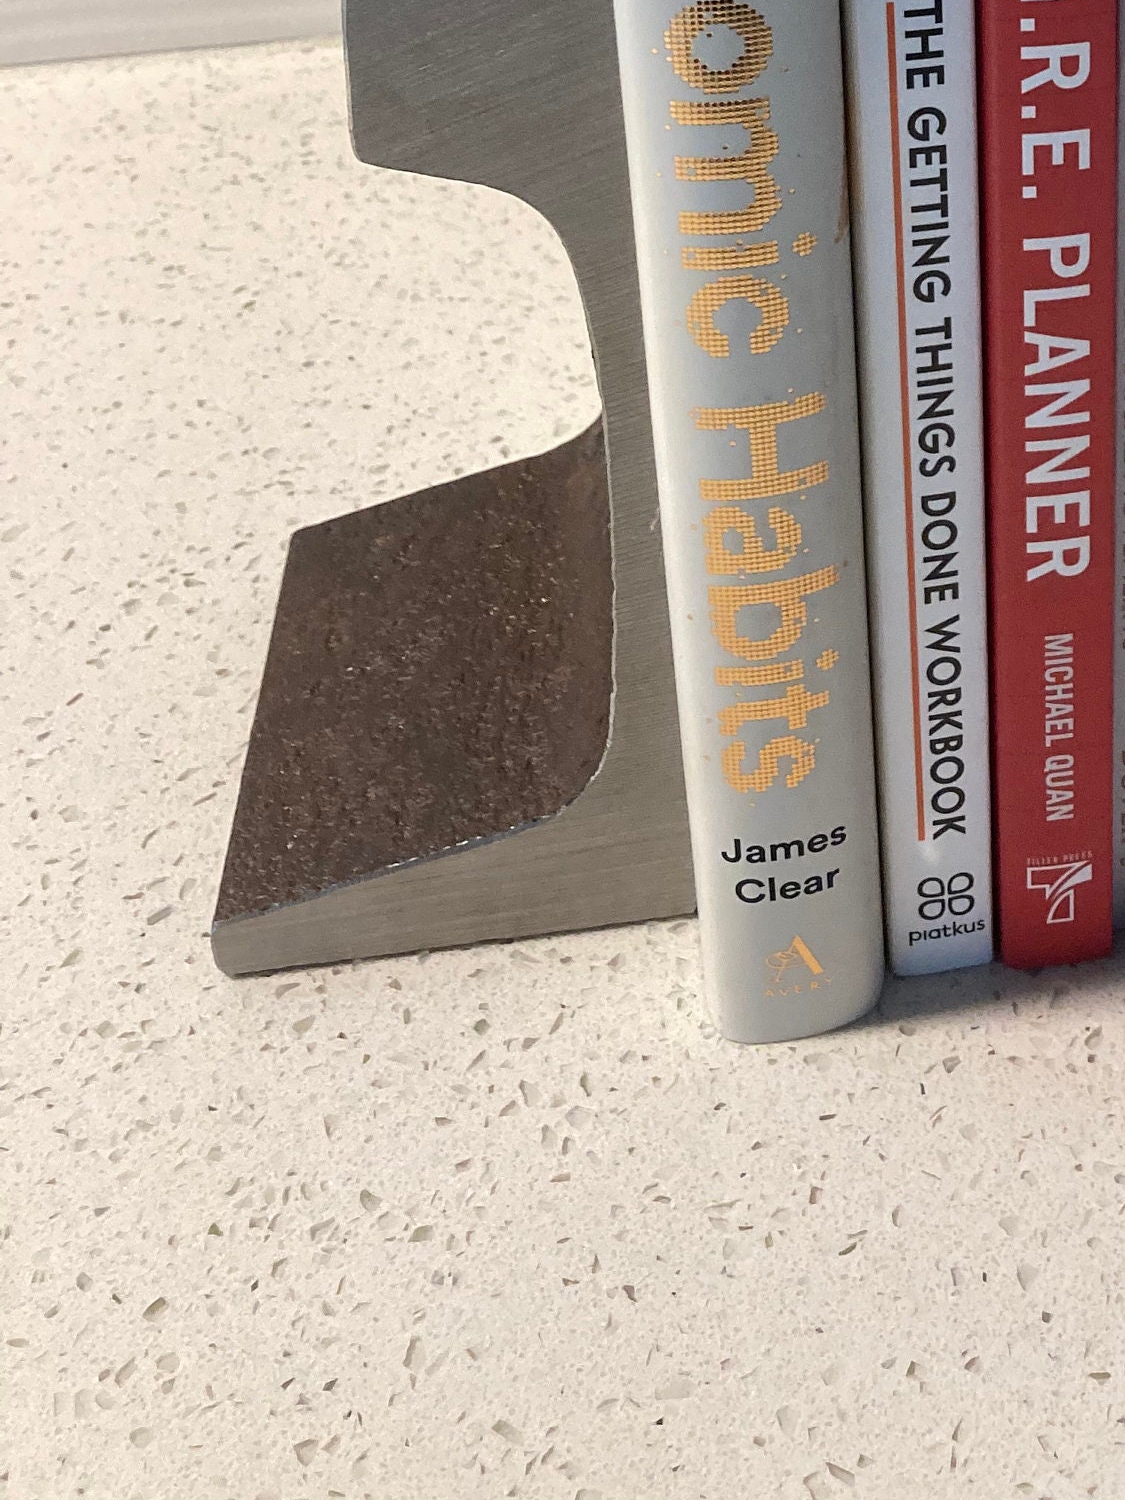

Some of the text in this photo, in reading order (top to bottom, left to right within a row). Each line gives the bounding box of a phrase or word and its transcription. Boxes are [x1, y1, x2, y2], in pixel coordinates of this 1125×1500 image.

[907, 106, 952, 303] GETTING
[914, 316, 957, 478] THINGS
[1022, 231, 1091, 582] PLANNER
[692, 391, 840, 793] Habits
[921, 491, 960, 606] DONE
[924, 614, 967, 840] WORKBOOK
[1044, 632, 1075, 822] MICHAEL QUAN
[721, 825, 847, 864] James
[735, 868, 840, 904] Clear
[908, 919, 986, 946] piatkus
